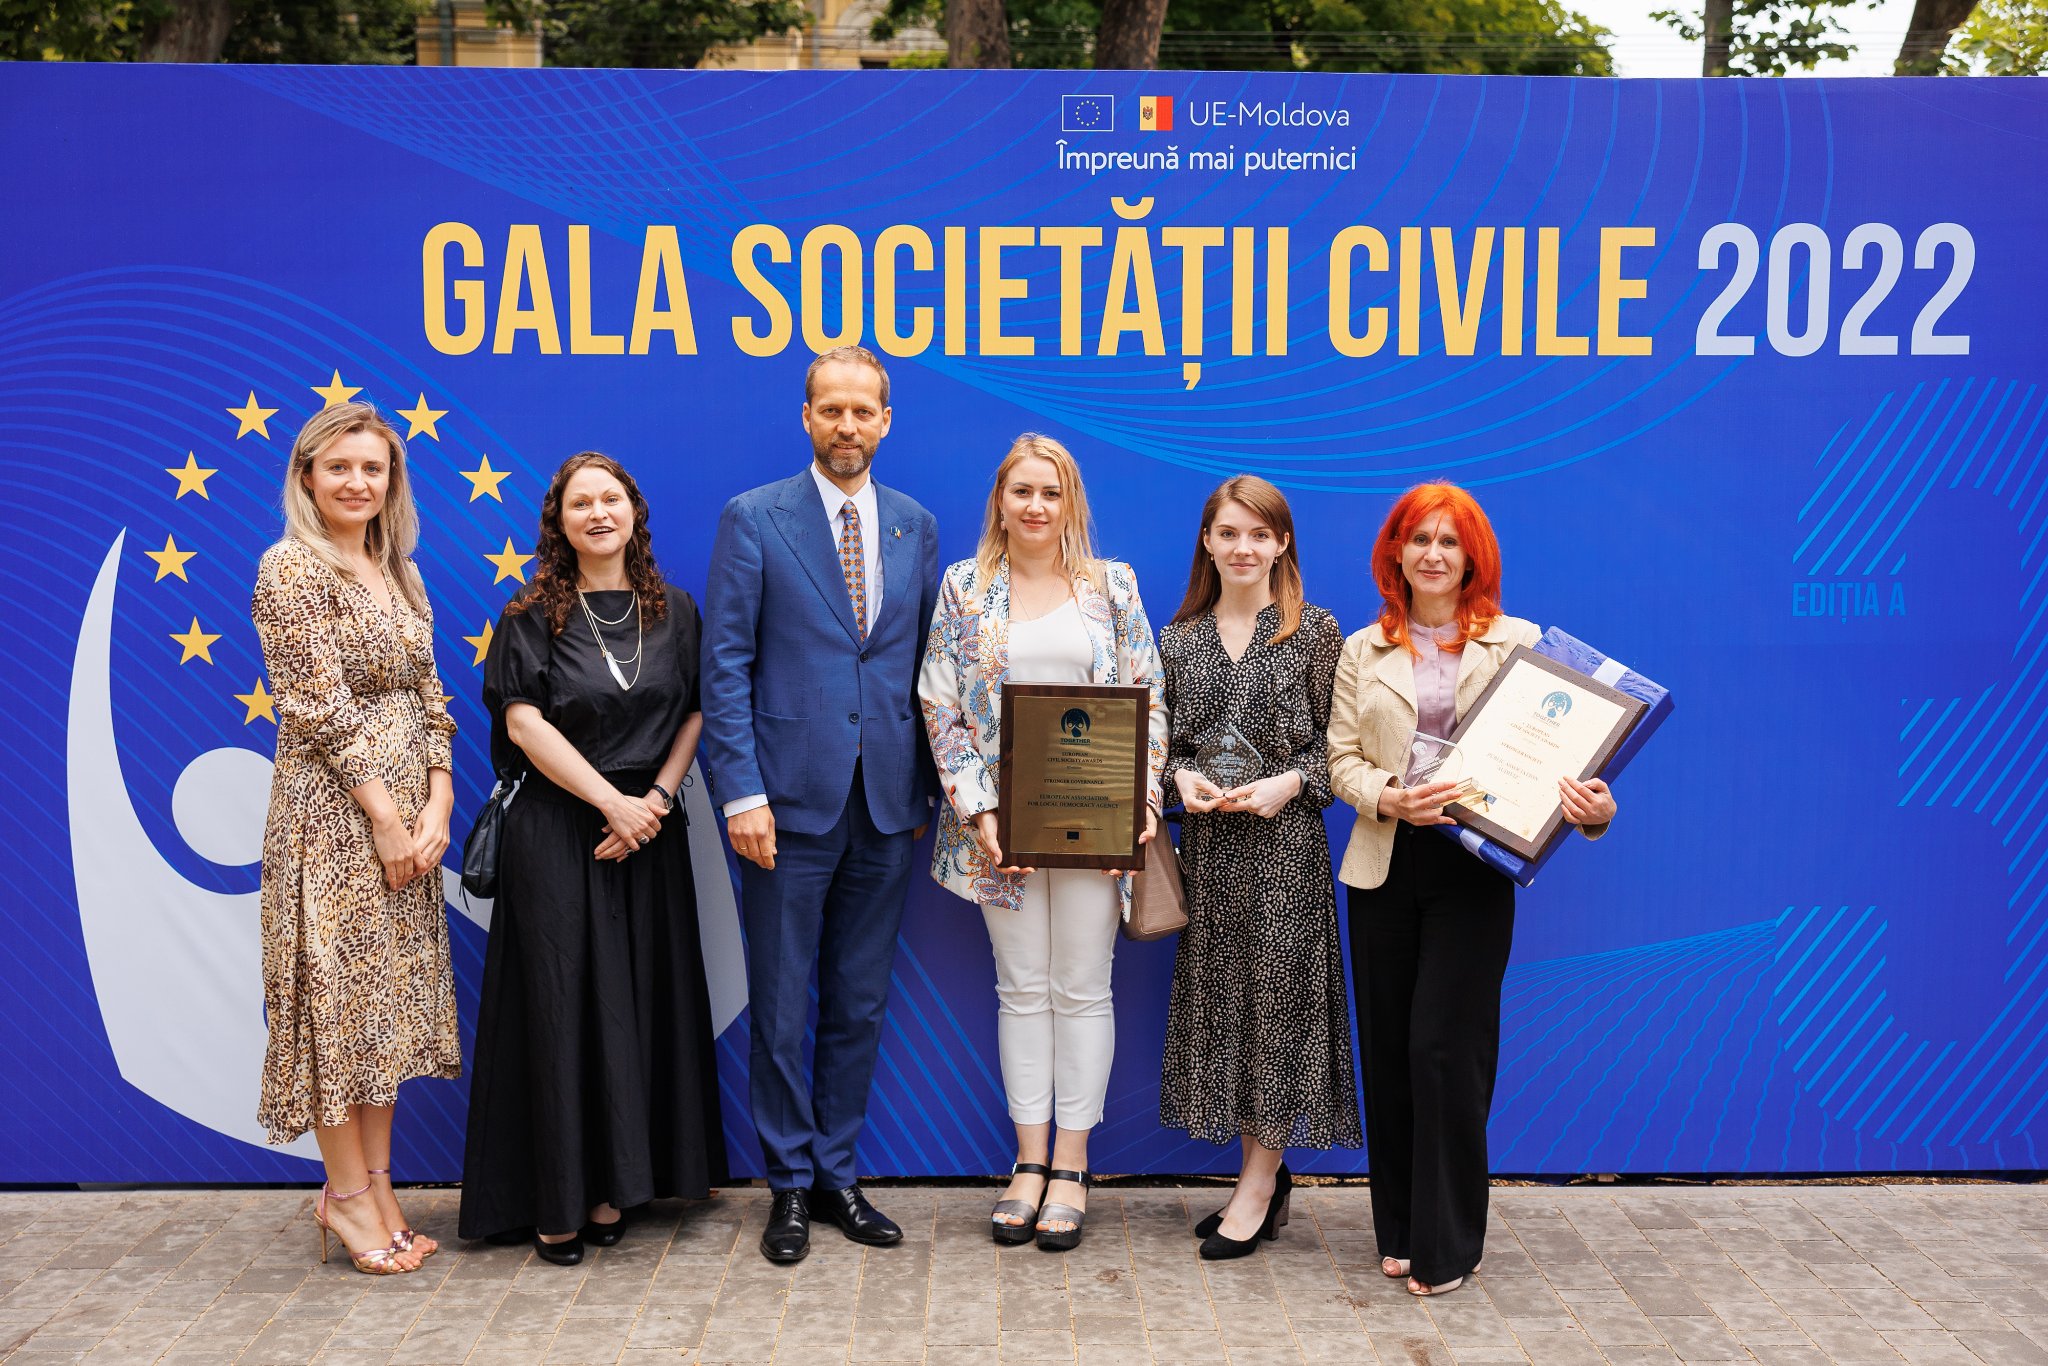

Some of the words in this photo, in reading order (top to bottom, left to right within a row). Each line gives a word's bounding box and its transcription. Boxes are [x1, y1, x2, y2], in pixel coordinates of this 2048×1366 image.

[1189, 101, 1350, 127] UE-Moldova
[1055, 138, 1179, 175] Împreună
[1189, 145, 1234, 170] mai
[1244, 145, 1356, 176] puternici
[422, 221, 698, 356] GALA
[731, 196, 1290, 391] SOCIETĂȚII
[1328, 225, 1656, 358] CIVILE
[1695, 222, 1976, 357] 2022
[1792, 581, 1880, 625] EDIȚIA
[1887, 581, 1907, 617] A
